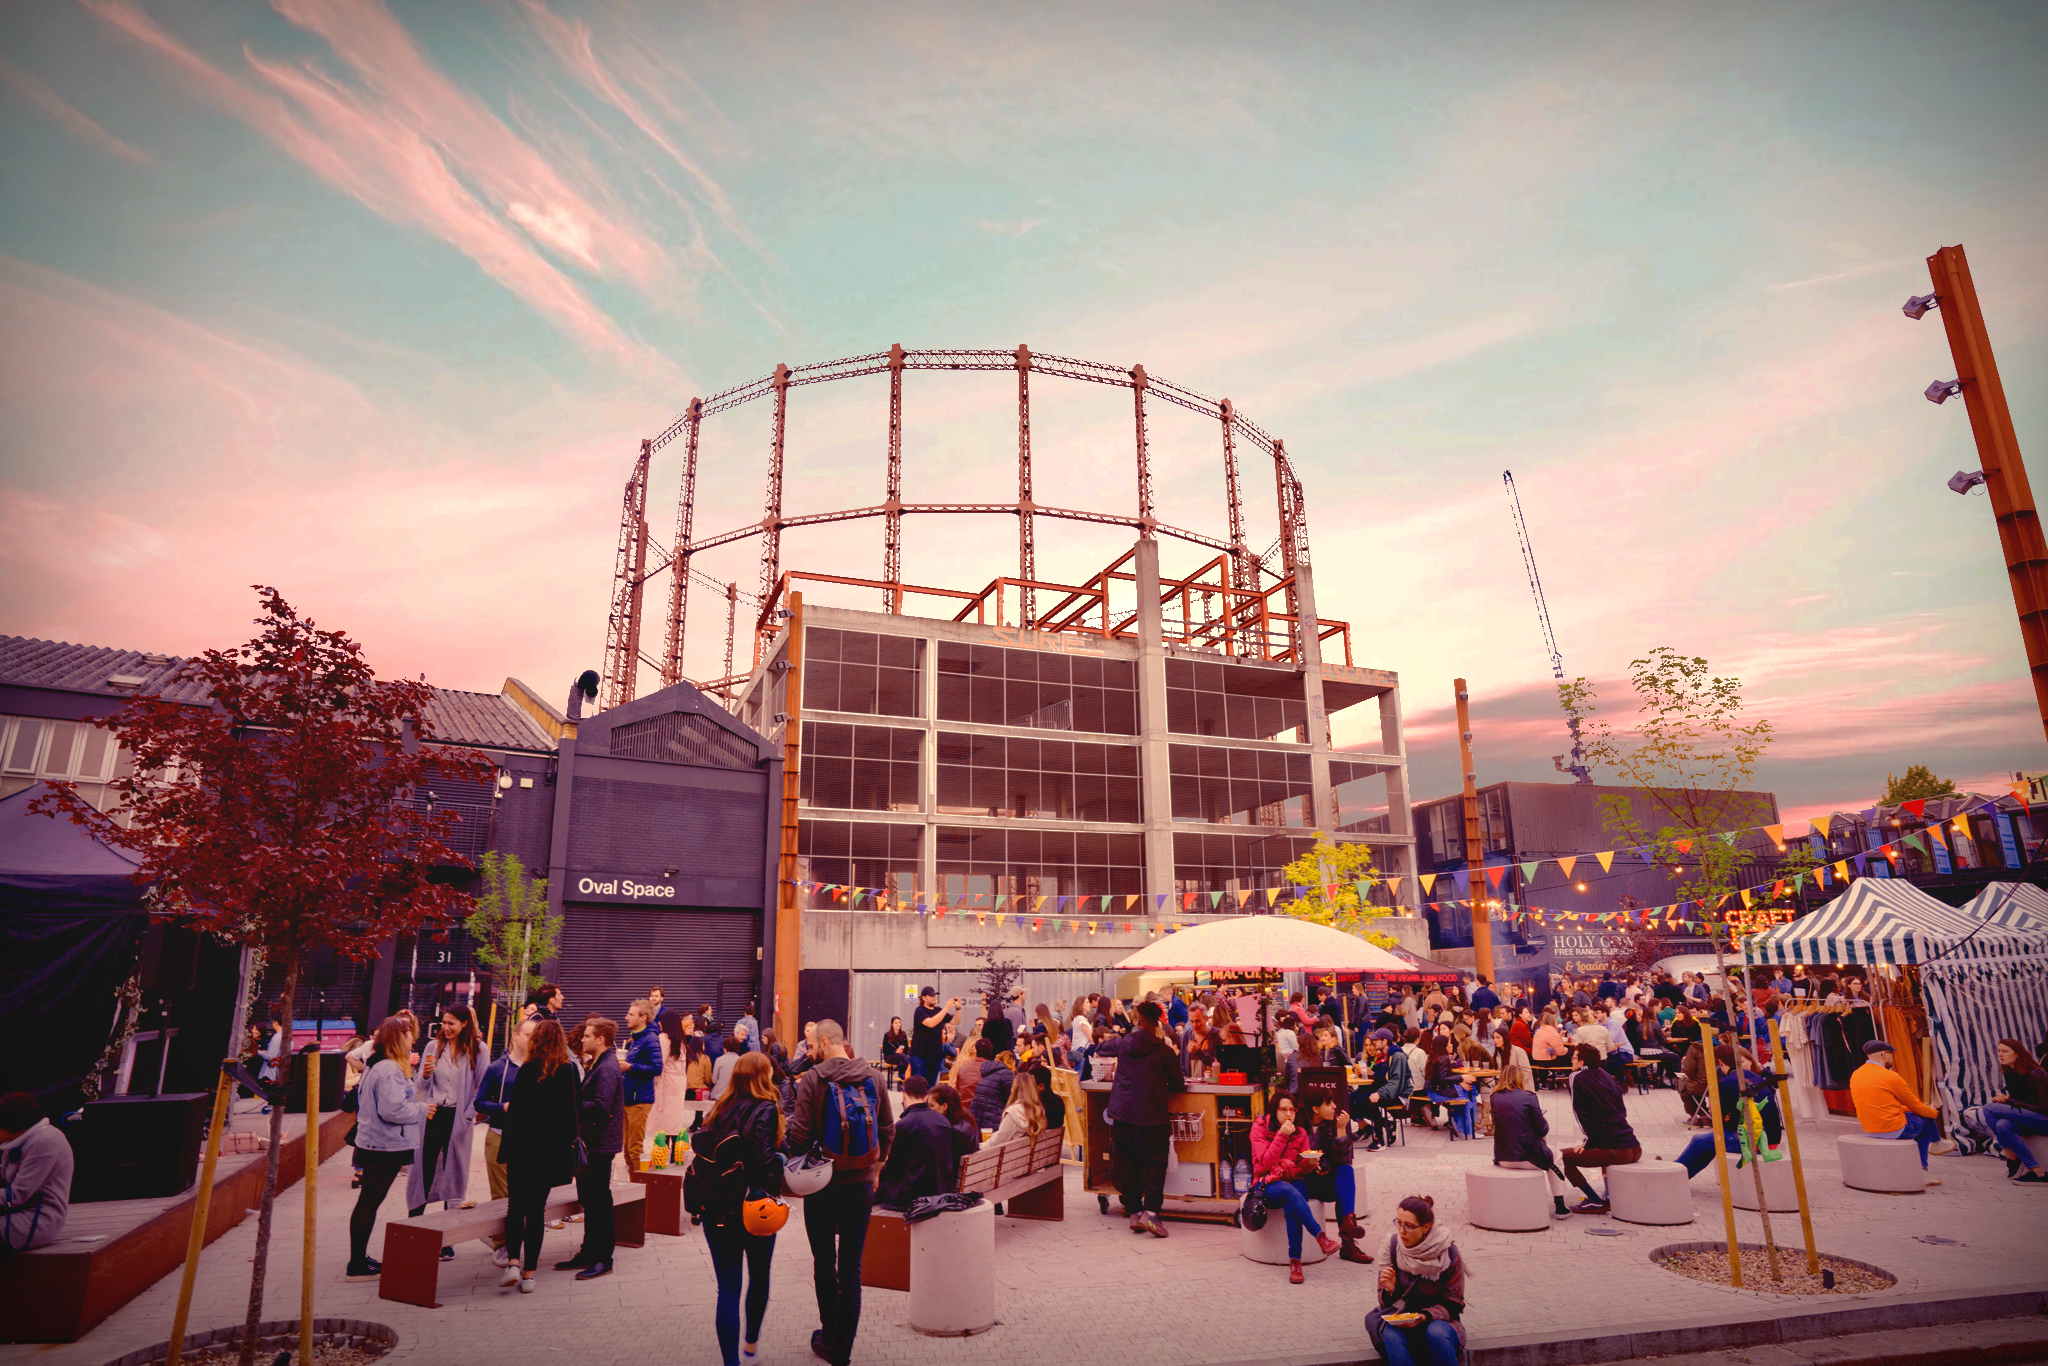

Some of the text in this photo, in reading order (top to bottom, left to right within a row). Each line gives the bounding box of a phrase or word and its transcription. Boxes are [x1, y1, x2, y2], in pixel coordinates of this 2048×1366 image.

[1321, 663, 1399, 688] ESCAPE
[578, 878, 675, 899] Oval Space
[1724, 909, 1796, 926] CRAFT
[1553, 935, 1595, 948] HOLY
[437, 951, 452, 963] 31
[1554, 948, 1574, 956] FREE
[1576, 948, 1601, 956] RANGE
[1438, 973, 1458, 982] FOOD
